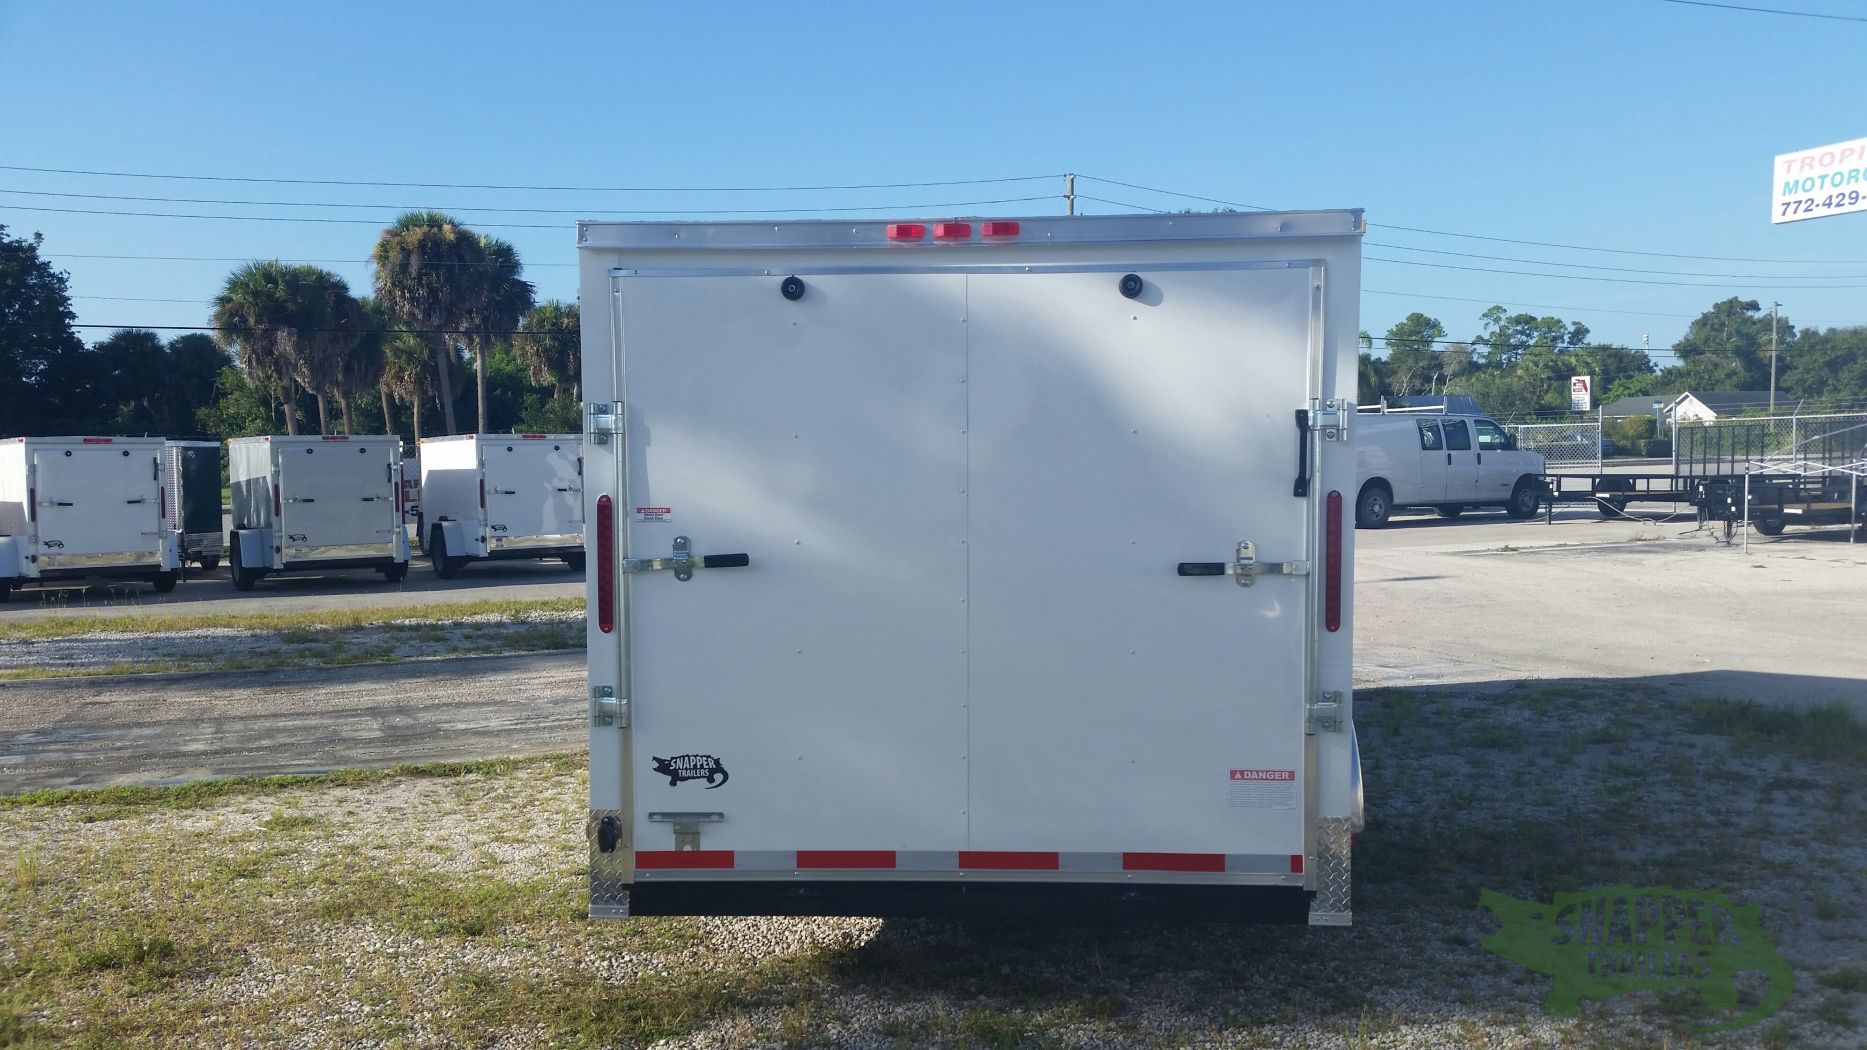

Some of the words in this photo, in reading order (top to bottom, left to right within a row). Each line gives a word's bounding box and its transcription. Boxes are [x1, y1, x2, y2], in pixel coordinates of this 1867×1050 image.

[669, 756, 716, 770] SNAPPER
[678, 769, 709, 777] TRAILERS
[1243, 771, 1289, 780] DANGER
